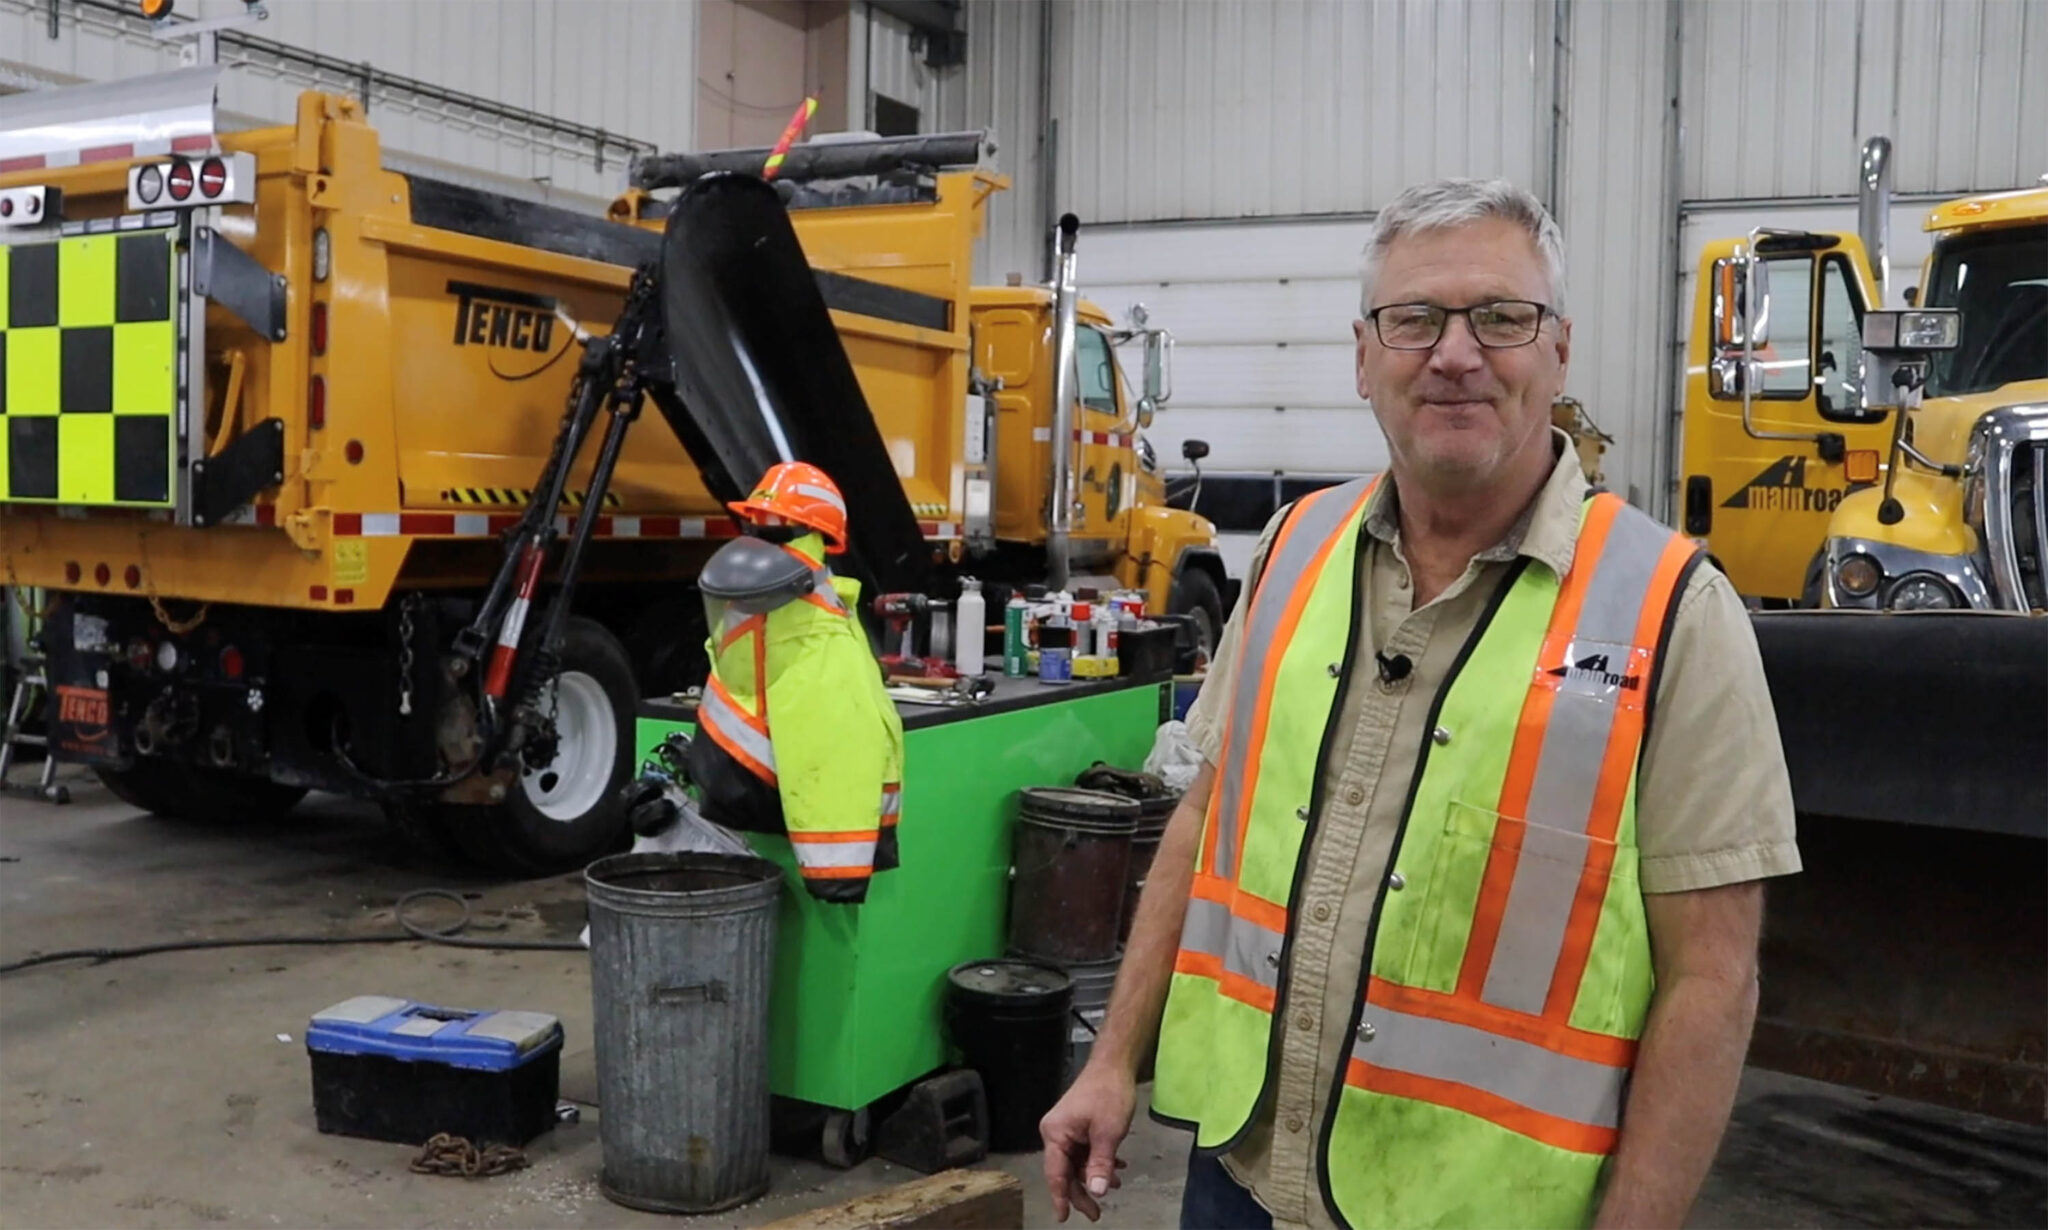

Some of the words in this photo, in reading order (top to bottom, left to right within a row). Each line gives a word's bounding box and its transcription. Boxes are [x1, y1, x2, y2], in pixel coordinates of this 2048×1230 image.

[446, 280, 556, 352] TENCO
[1747, 486, 1849, 513] mainroa
[1566, 666, 1640, 691] mainroad
[56, 685, 109, 725] TENCO
